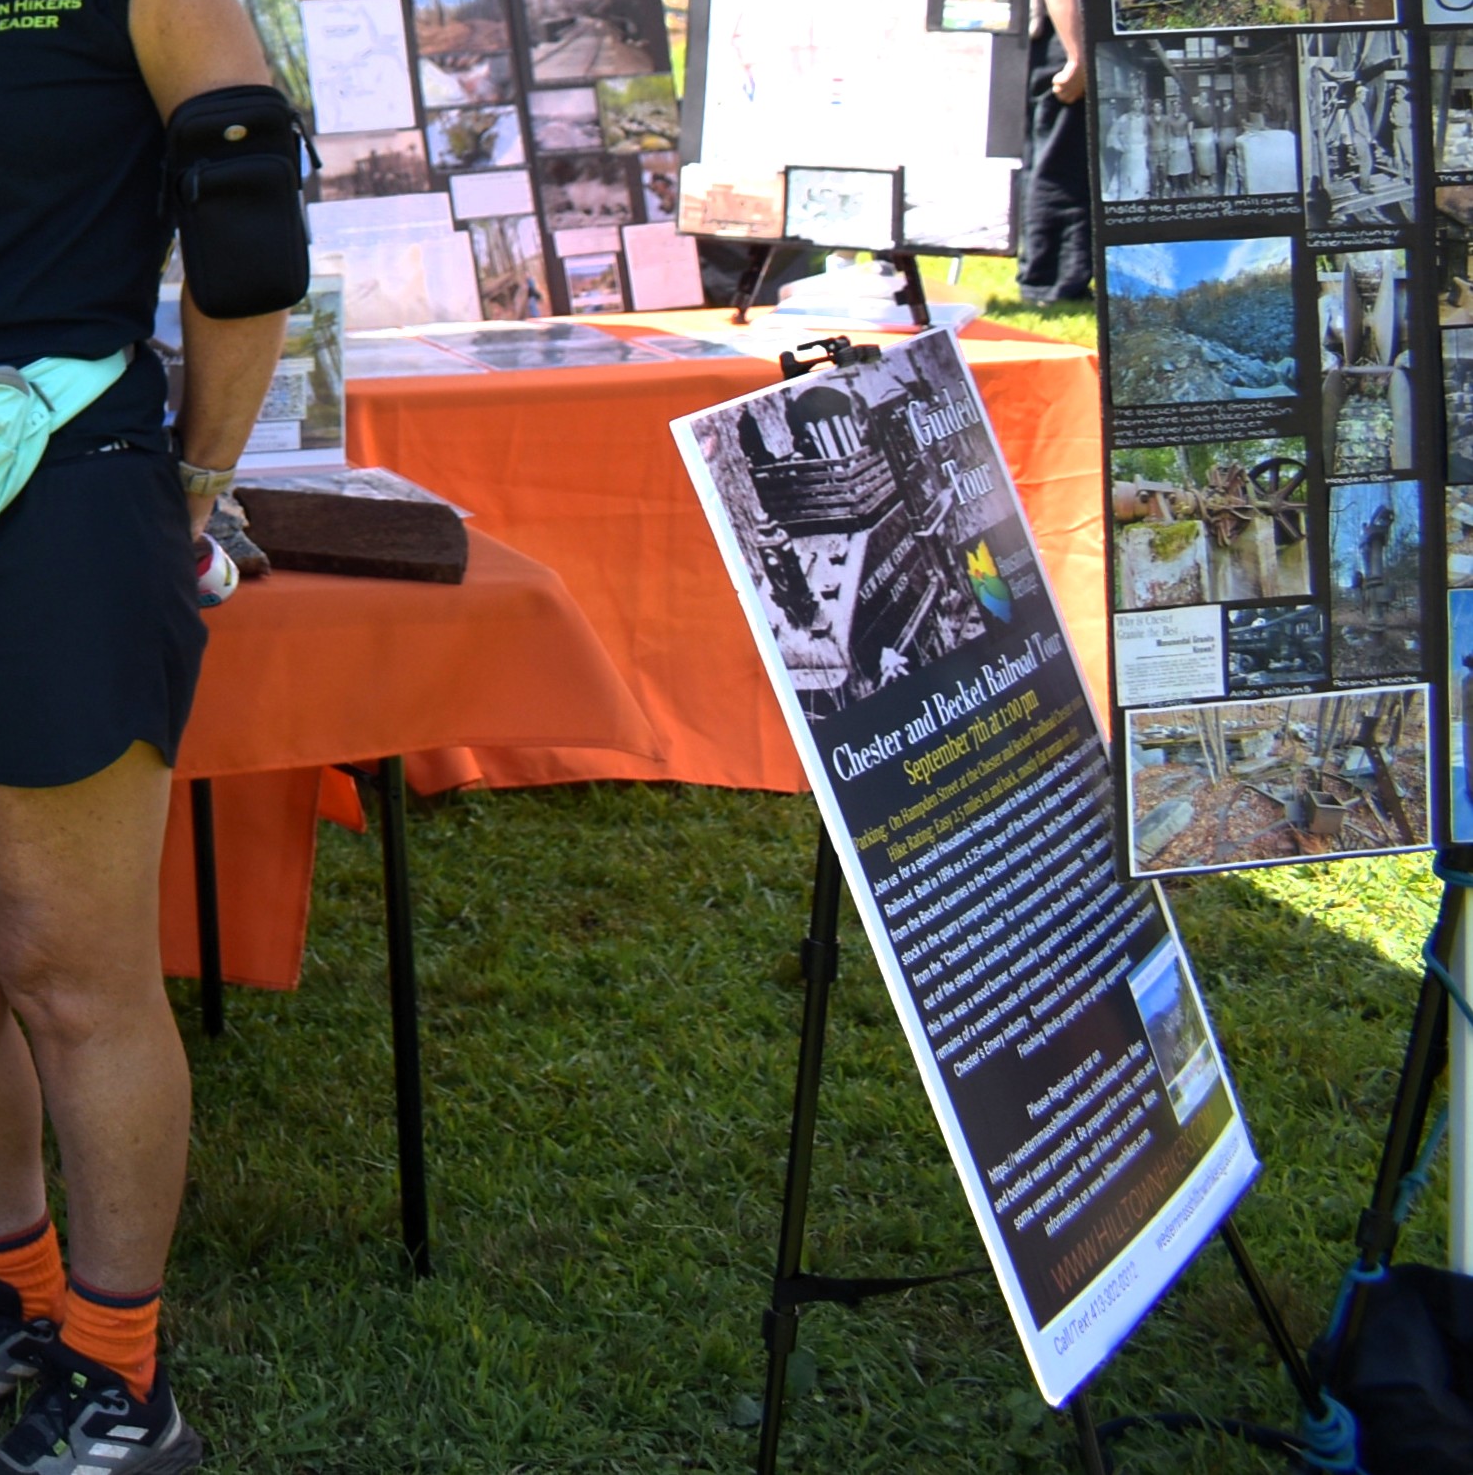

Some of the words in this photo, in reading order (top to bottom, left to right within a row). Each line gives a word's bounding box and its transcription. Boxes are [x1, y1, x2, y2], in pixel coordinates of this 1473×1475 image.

[1104, 203, 1147, 215] Inside
[1149, 203, 1172, 213] the
[1175, 199, 1232, 214] polishing
[908, 380, 980, 447] Guided
[941, 460, 994, 506] Tour
[832, 730, 903, 781] Chester
[905, 700, 937, 745] and
[931, 677, 988, 726] Becket
[981, 638, 1039, 696] Railroad
[1031, 631, 1063, 663] Tour
[903, 729, 970, 785] September
[968, 717, 991, 751] 7th
[990, 716, 1003, 735] at
[999, 696, 1024, 728] 1:00
[1020, 689, 1039, 721] pm
